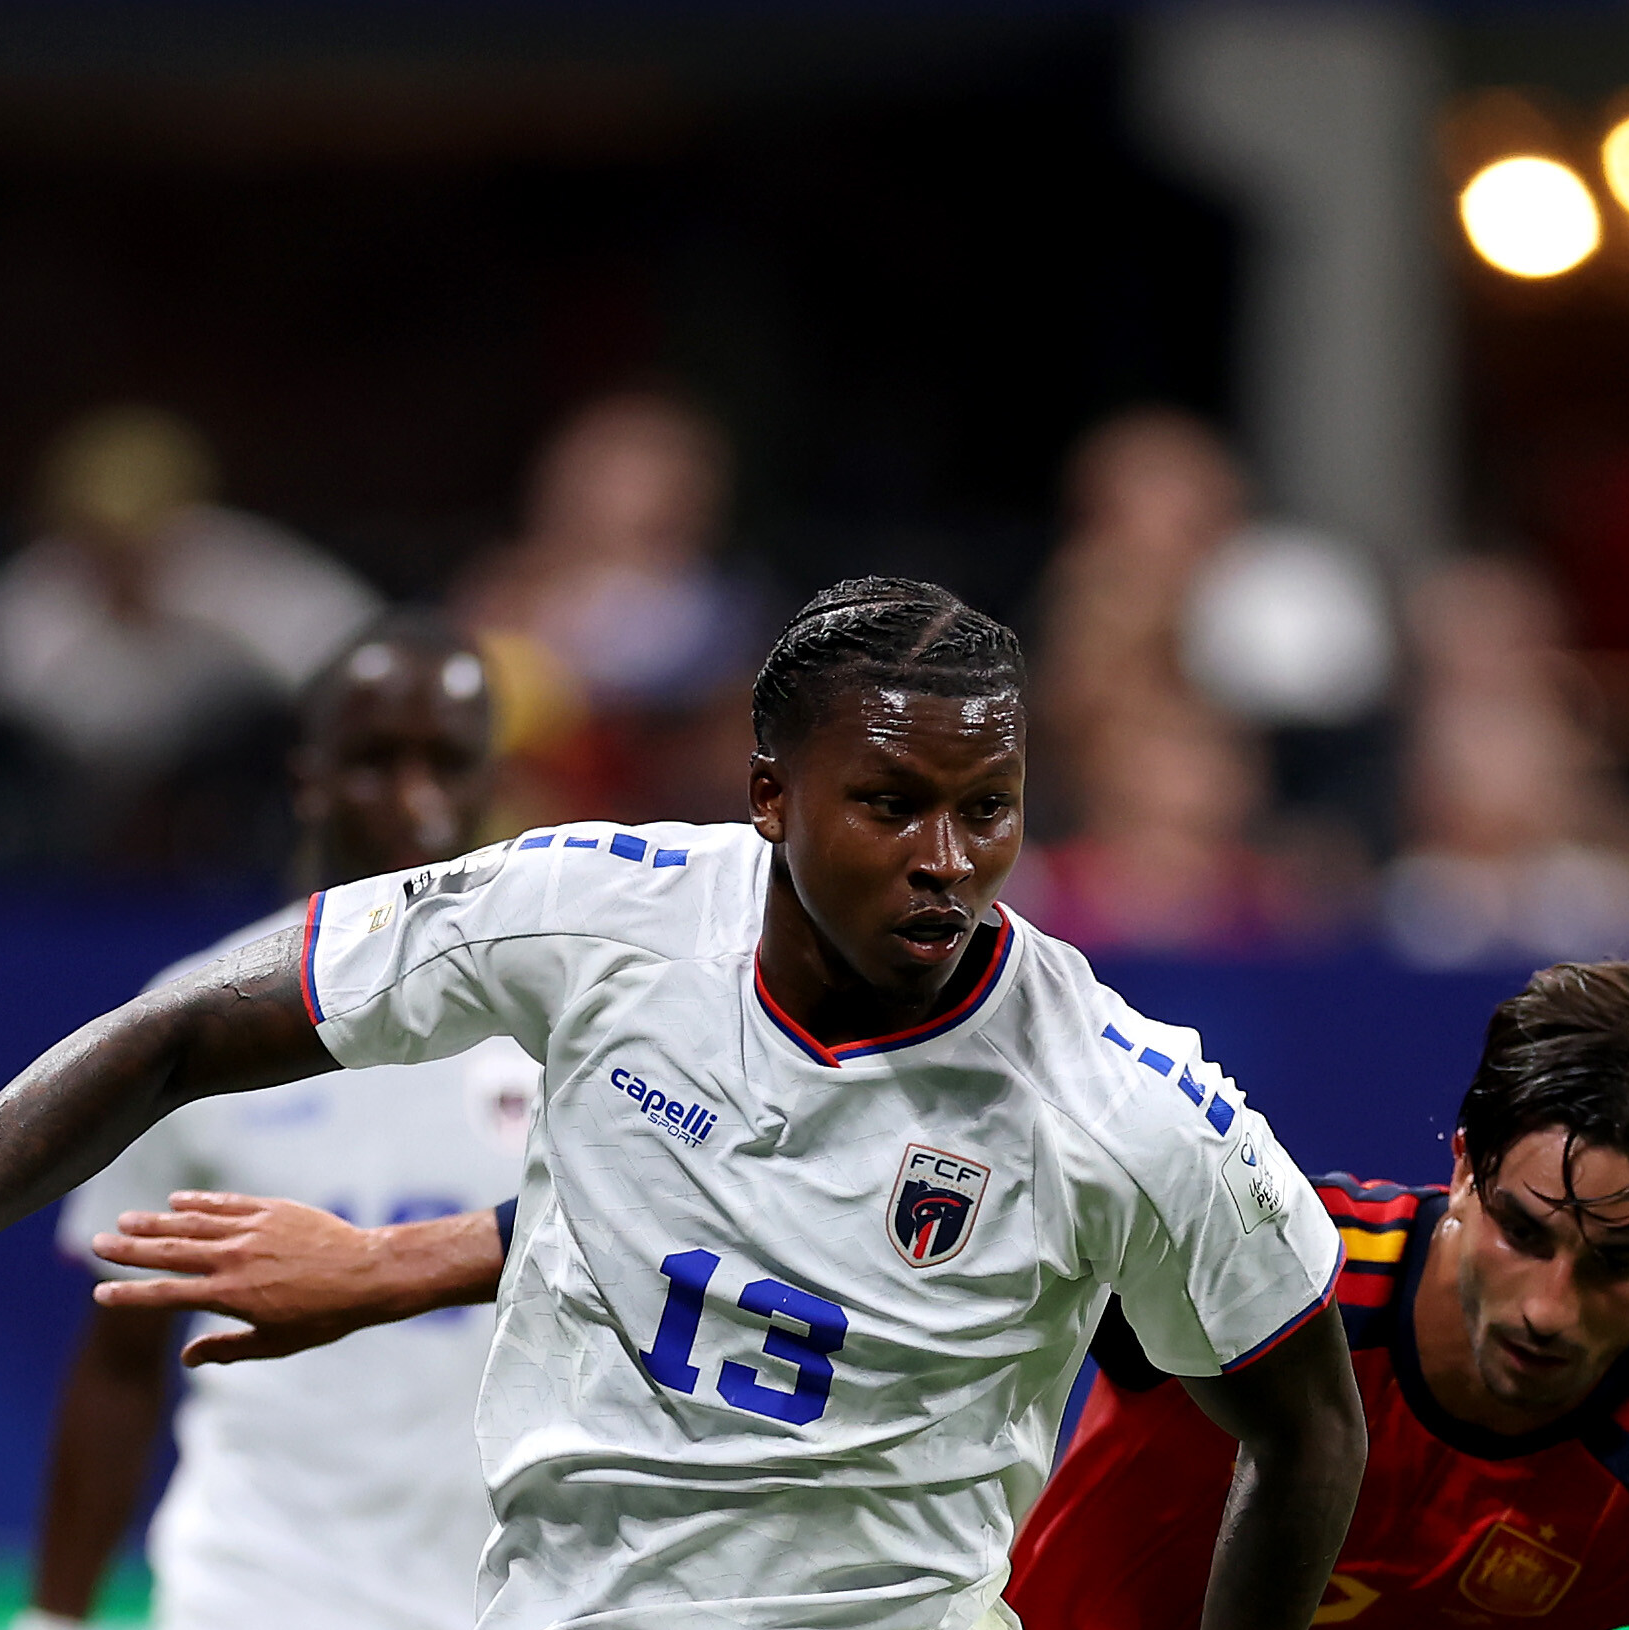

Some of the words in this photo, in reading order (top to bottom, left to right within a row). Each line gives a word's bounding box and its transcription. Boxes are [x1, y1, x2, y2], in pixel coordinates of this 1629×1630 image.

[611, 1068, 718, 1140] capelli
[647, 1112, 702, 1148] SPORT
[910, 1153, 981, 1182] FCF
[639, 1248, 849, 1427] 13
